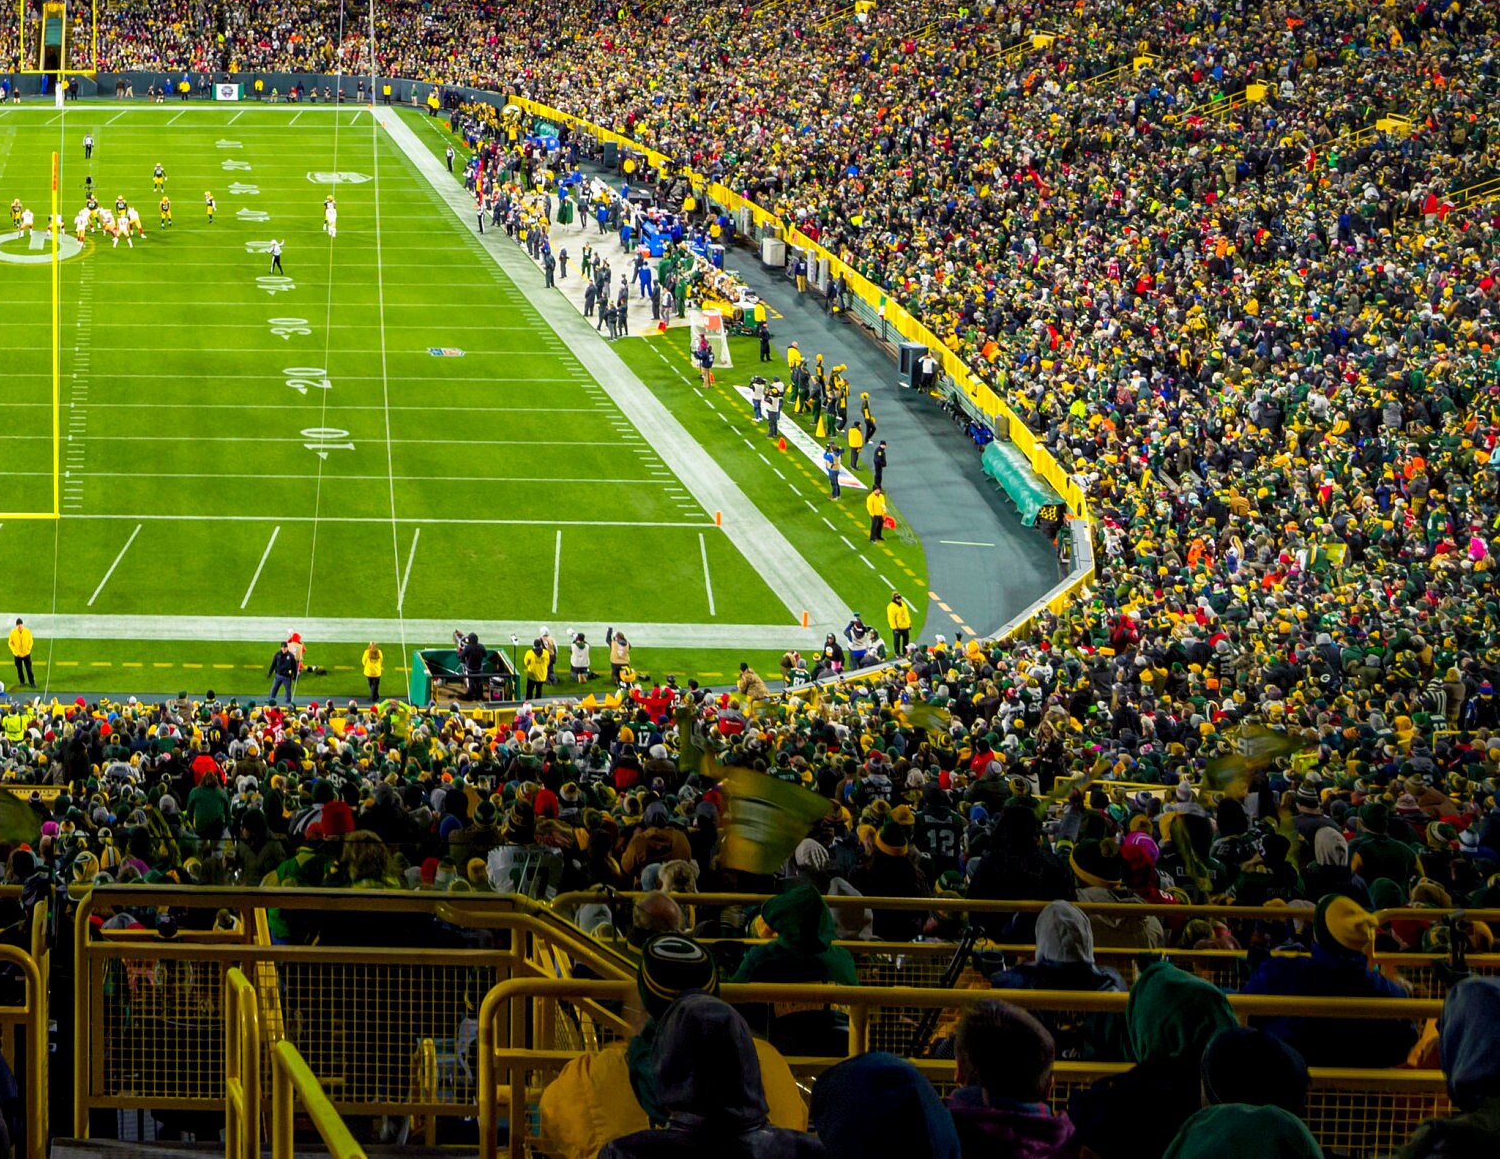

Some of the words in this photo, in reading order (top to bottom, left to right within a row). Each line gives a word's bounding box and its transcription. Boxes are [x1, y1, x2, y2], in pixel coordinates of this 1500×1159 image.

[267, 317, 312, 335] 30
[282, 367, 332, 388] 20
[300, 427, 356, 451] 10
[638, 732, 651, 747] 17
[926, 828, 955, 857] 12
